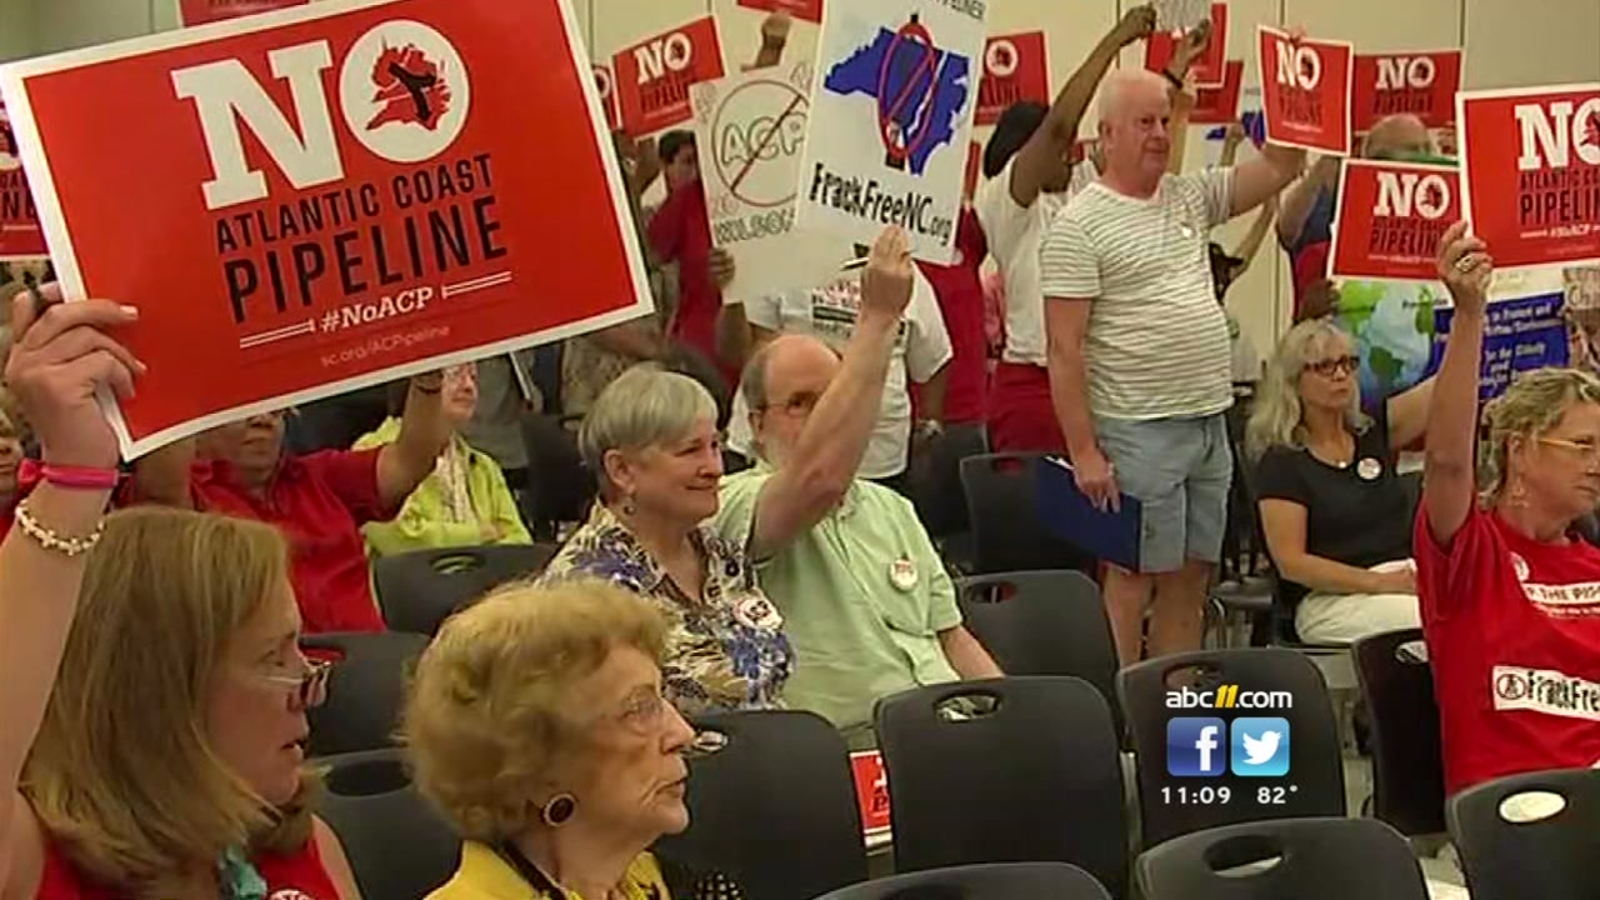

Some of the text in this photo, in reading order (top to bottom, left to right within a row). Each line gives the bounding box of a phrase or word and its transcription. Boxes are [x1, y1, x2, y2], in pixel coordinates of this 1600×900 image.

[634, 32, 692, 85] NO
[1276, 40, 1320, 90] NO
[1375, 56, 1435, 90] NO
[171, 19, 470, 210] NO
[217, 153, 495, 254] ATLANTIC COAST
[809, 162, 953, 247] FrackFreeNC.org
[1373, 171, 1450, 219] NO
[222, 196, 508, 324] PIPELINE
[1369, 229, 1440, 257] PIPELIN
[320, 285, 434, 333] #NoACP
[320, 325, 451, 367] sc.org/ACPipeline
